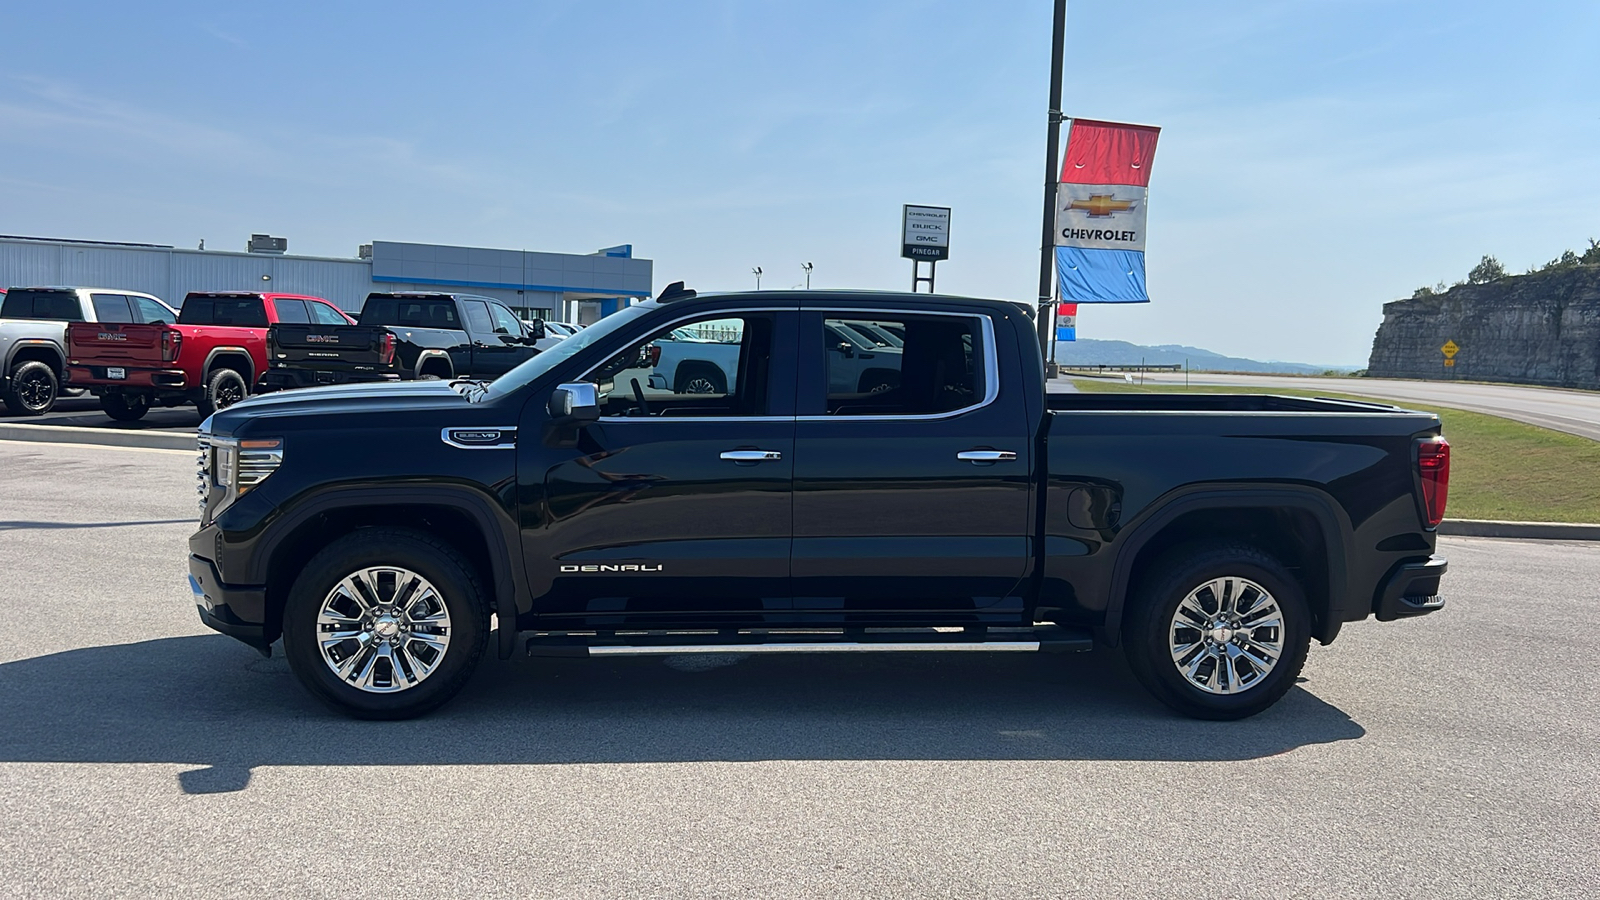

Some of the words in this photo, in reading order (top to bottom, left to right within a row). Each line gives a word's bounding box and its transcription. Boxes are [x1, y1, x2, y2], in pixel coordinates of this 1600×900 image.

[1061, 228, 1136, 242] CHEVROLET
[912, 247, 940, 256] PINEGAR
[98, 332, 127, 341] GMC
[306, 334, 339, 343] GMC
[560, 564, 663, 572] DENALI
